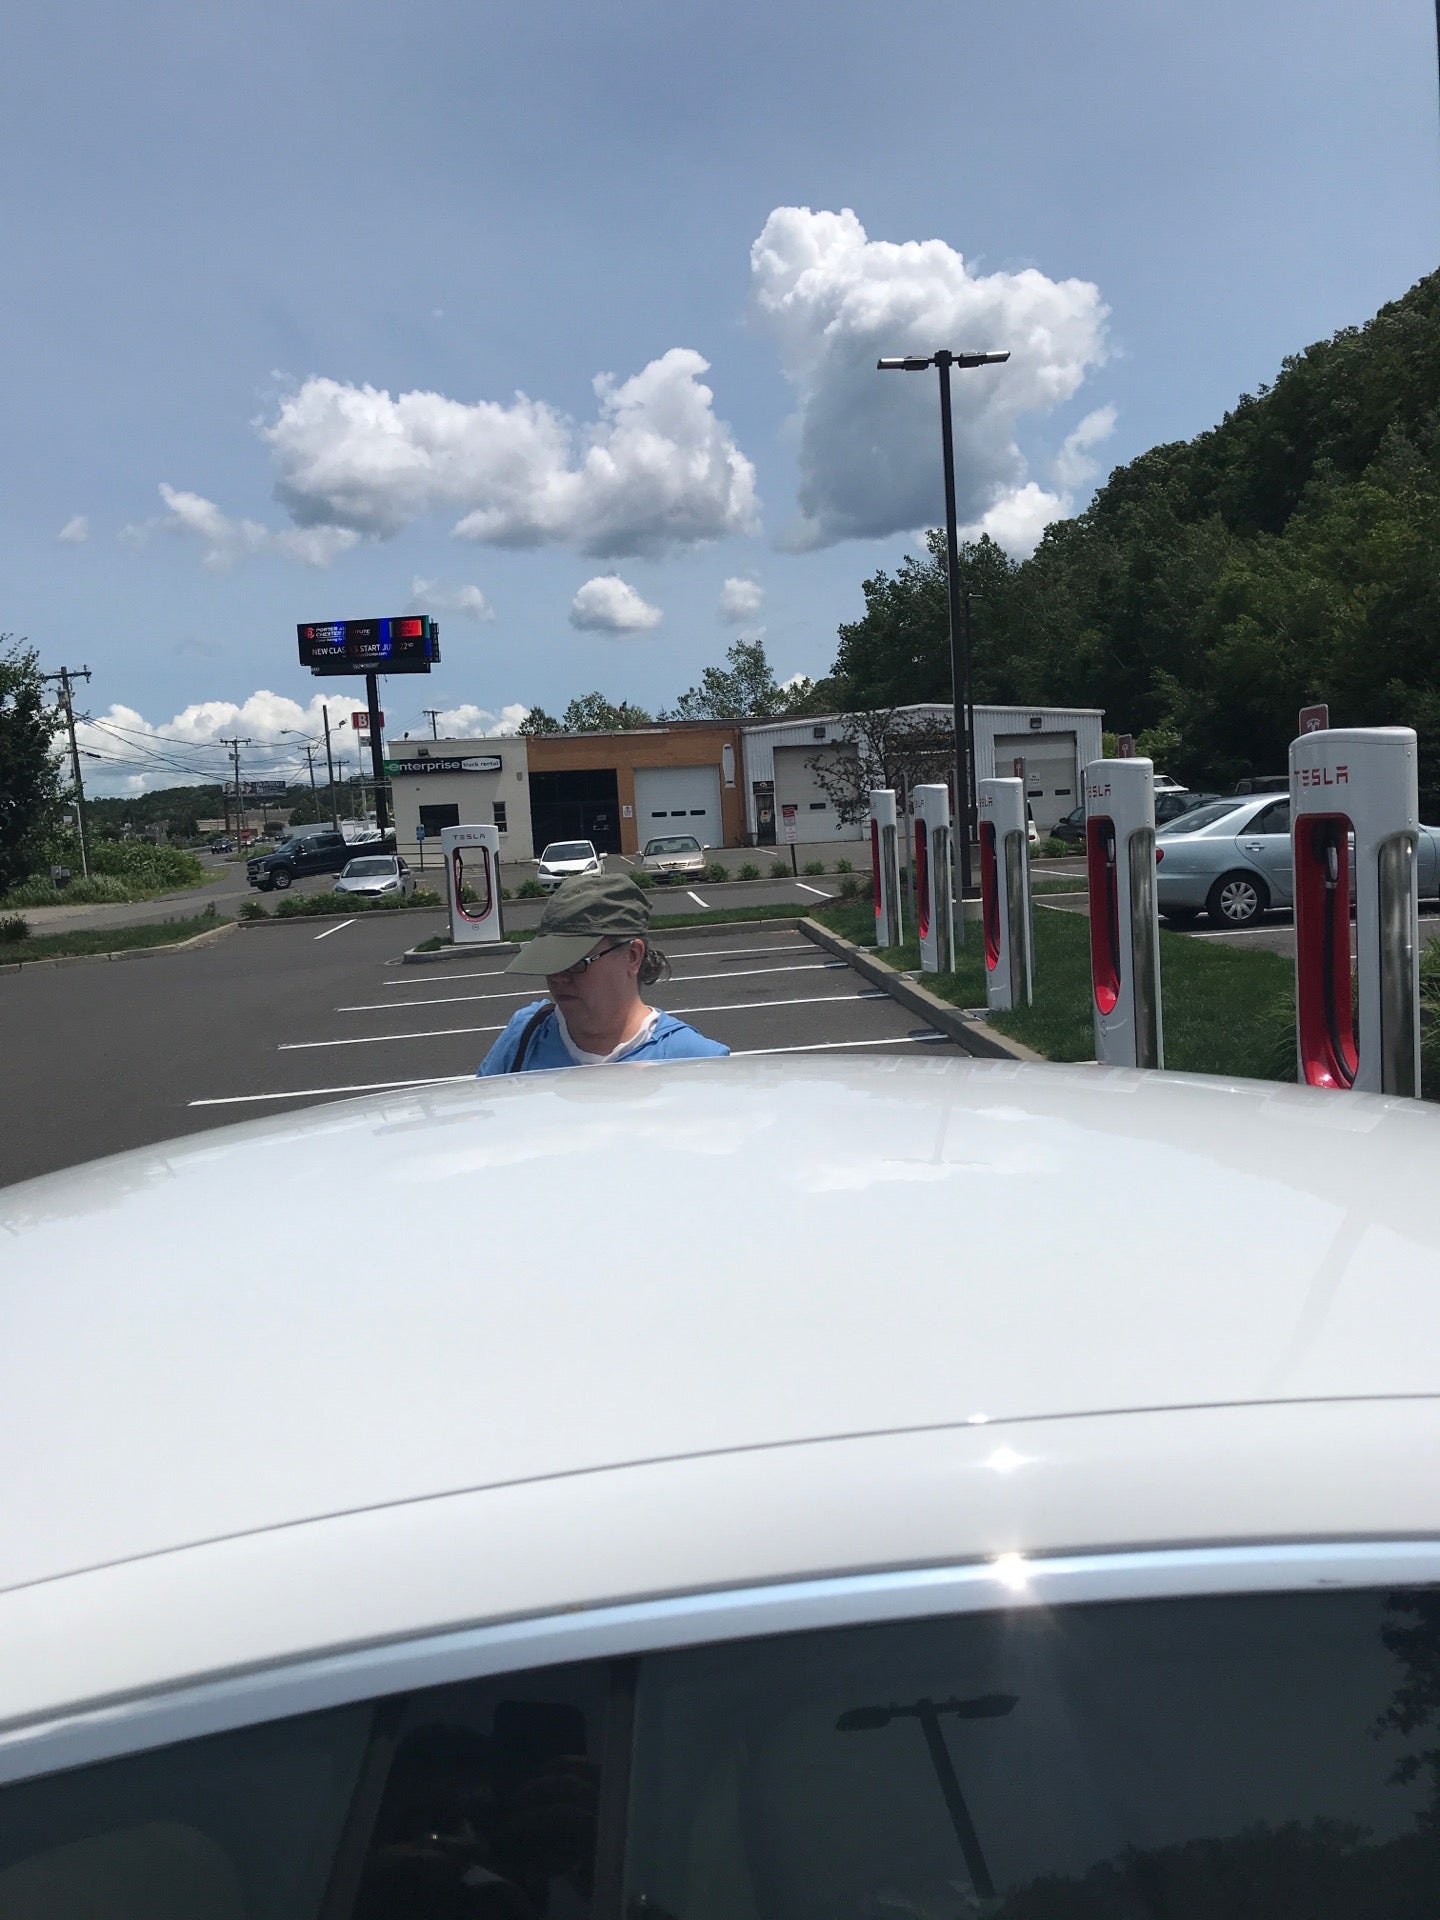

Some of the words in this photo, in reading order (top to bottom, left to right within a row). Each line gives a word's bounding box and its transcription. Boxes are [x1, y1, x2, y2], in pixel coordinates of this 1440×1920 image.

[312, 647, 328, 656] NEW
[360, 644, 380, 653] START
[388, 760, 460, 772] enterprise
